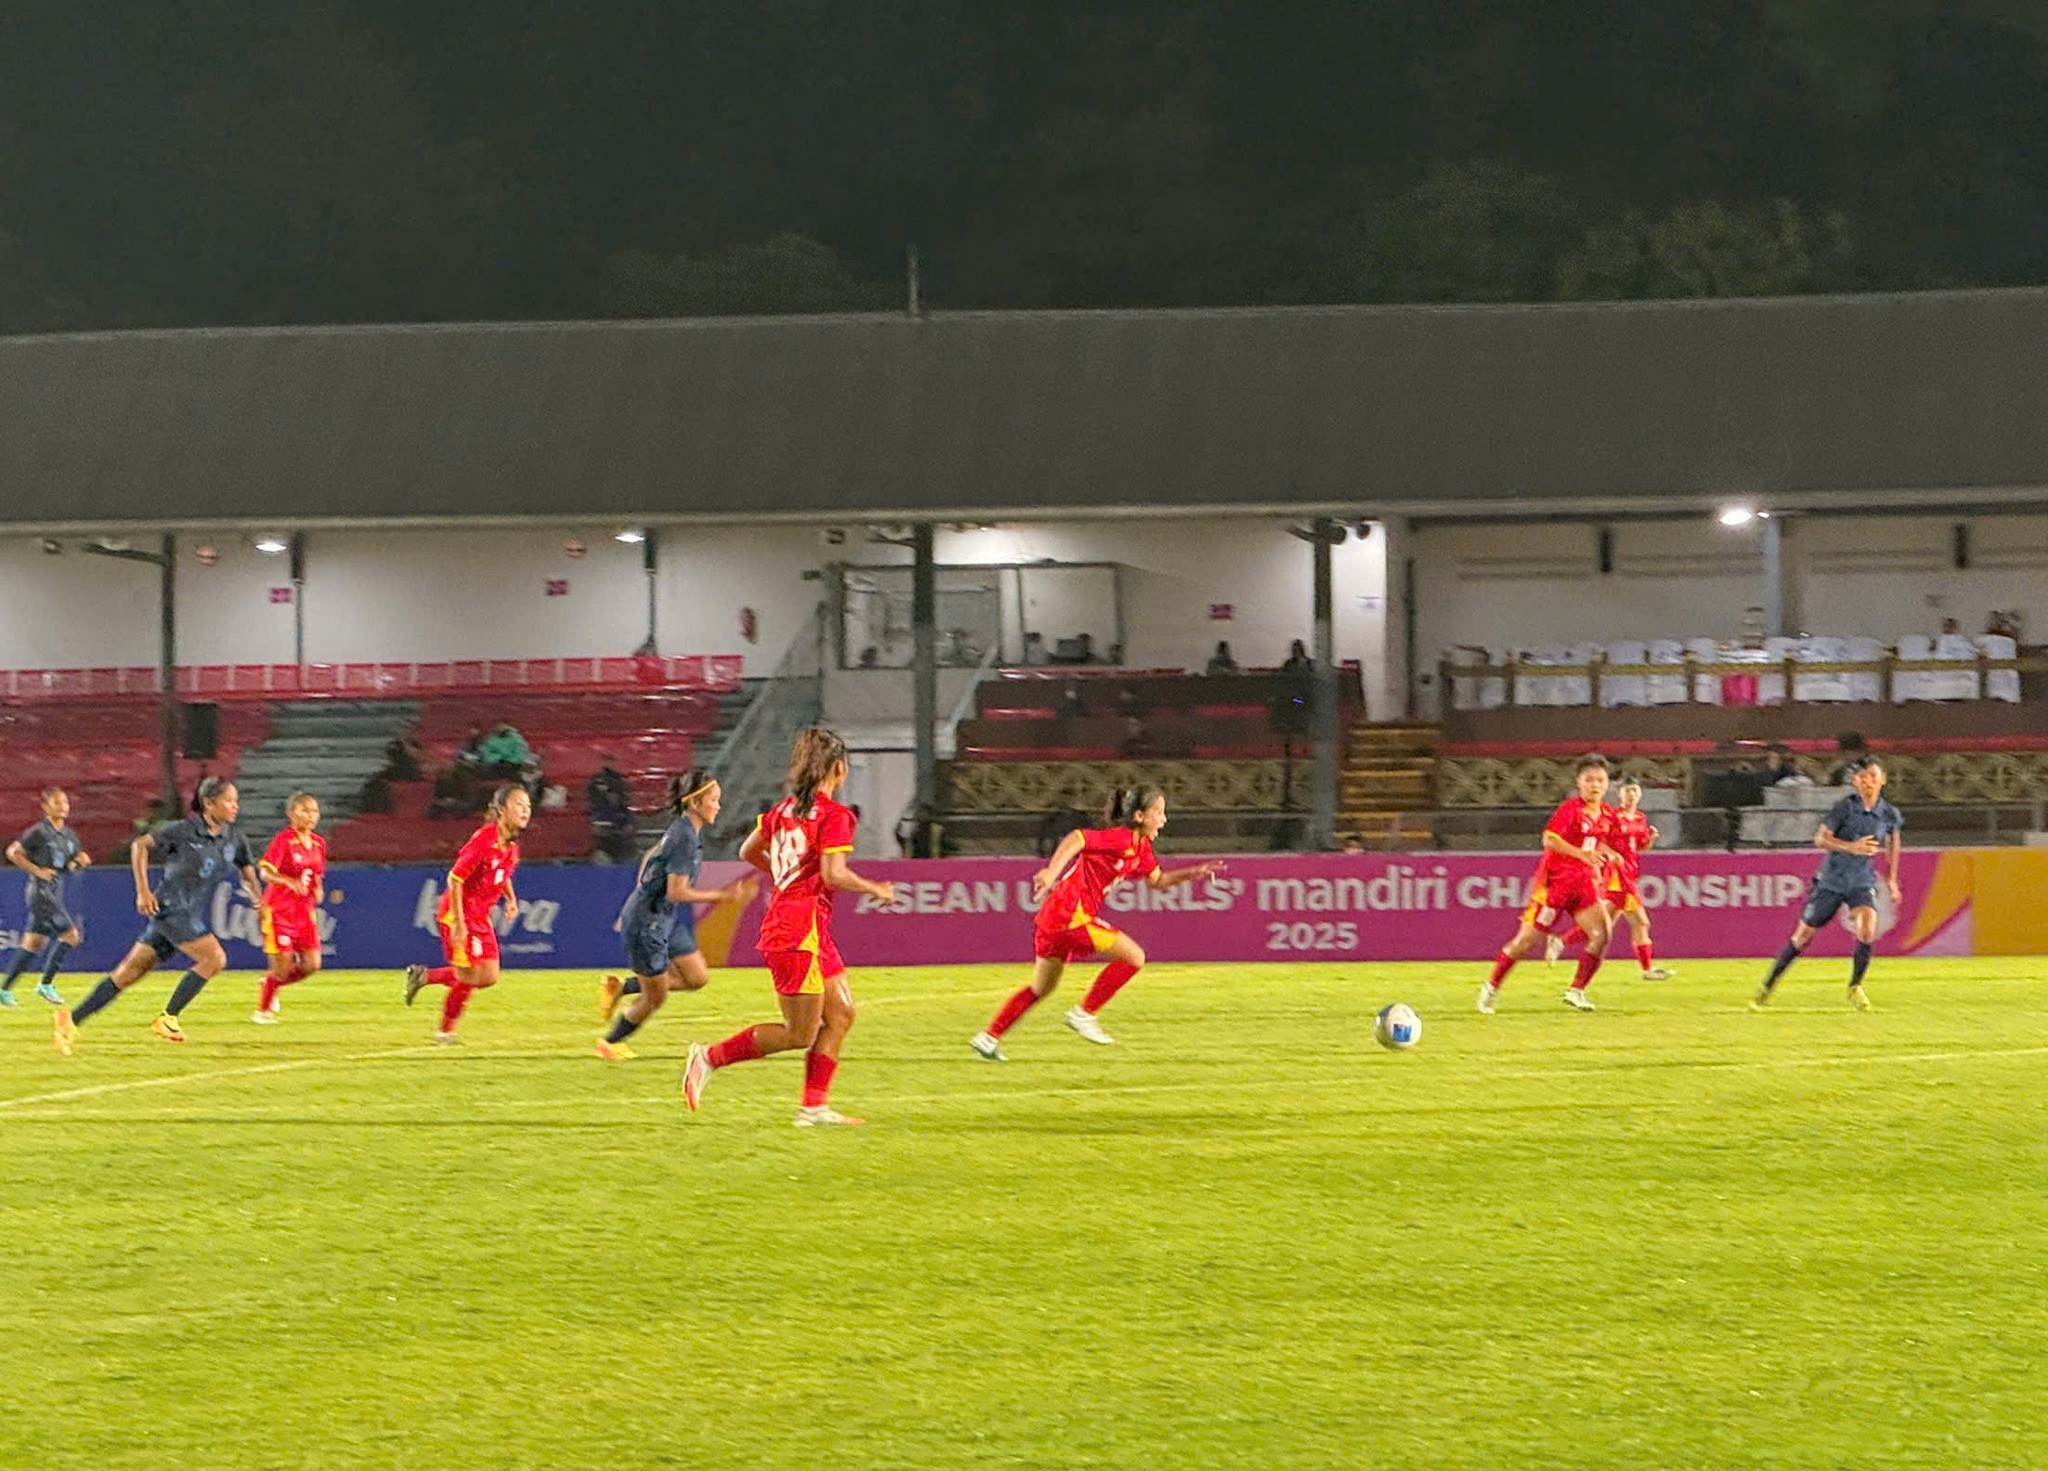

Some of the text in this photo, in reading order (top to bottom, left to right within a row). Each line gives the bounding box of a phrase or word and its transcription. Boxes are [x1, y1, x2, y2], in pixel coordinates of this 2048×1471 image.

[1257, 865, 1448, 911] mandiri
[1457, 874, 1804, 909] CHONSHIP
[1265, 921, 1359, 951] 2025
